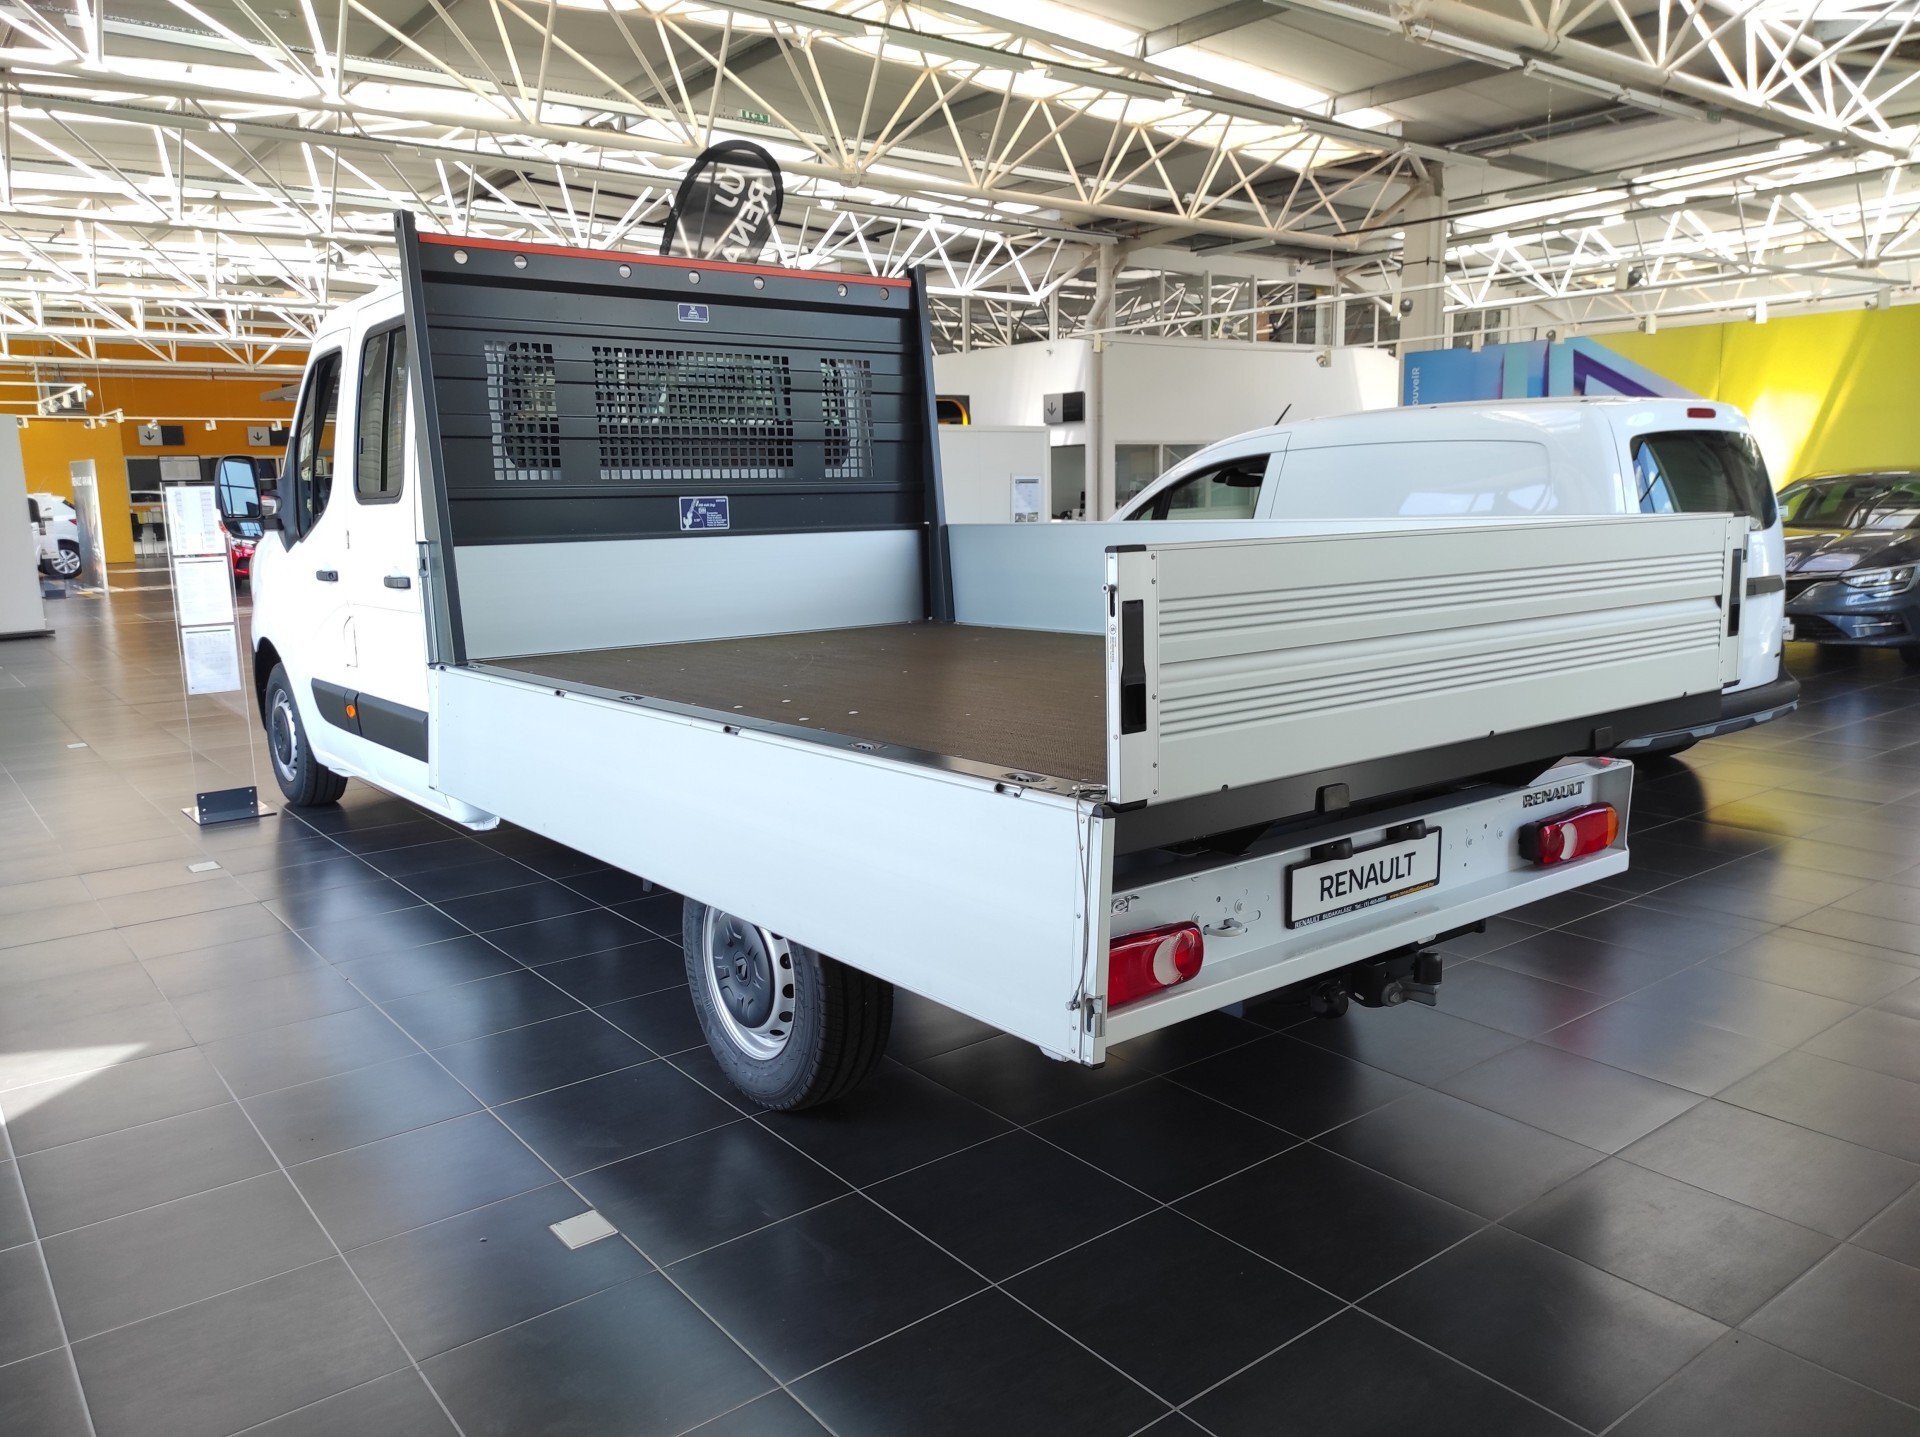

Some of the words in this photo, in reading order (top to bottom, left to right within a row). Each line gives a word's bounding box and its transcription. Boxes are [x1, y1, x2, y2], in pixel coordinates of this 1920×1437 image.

[1523, 781, 1584, 808] RENAULT
[1320, 851, 1416, 902] RENAULT
[1295, 914, 1320, 928] RENAULT
